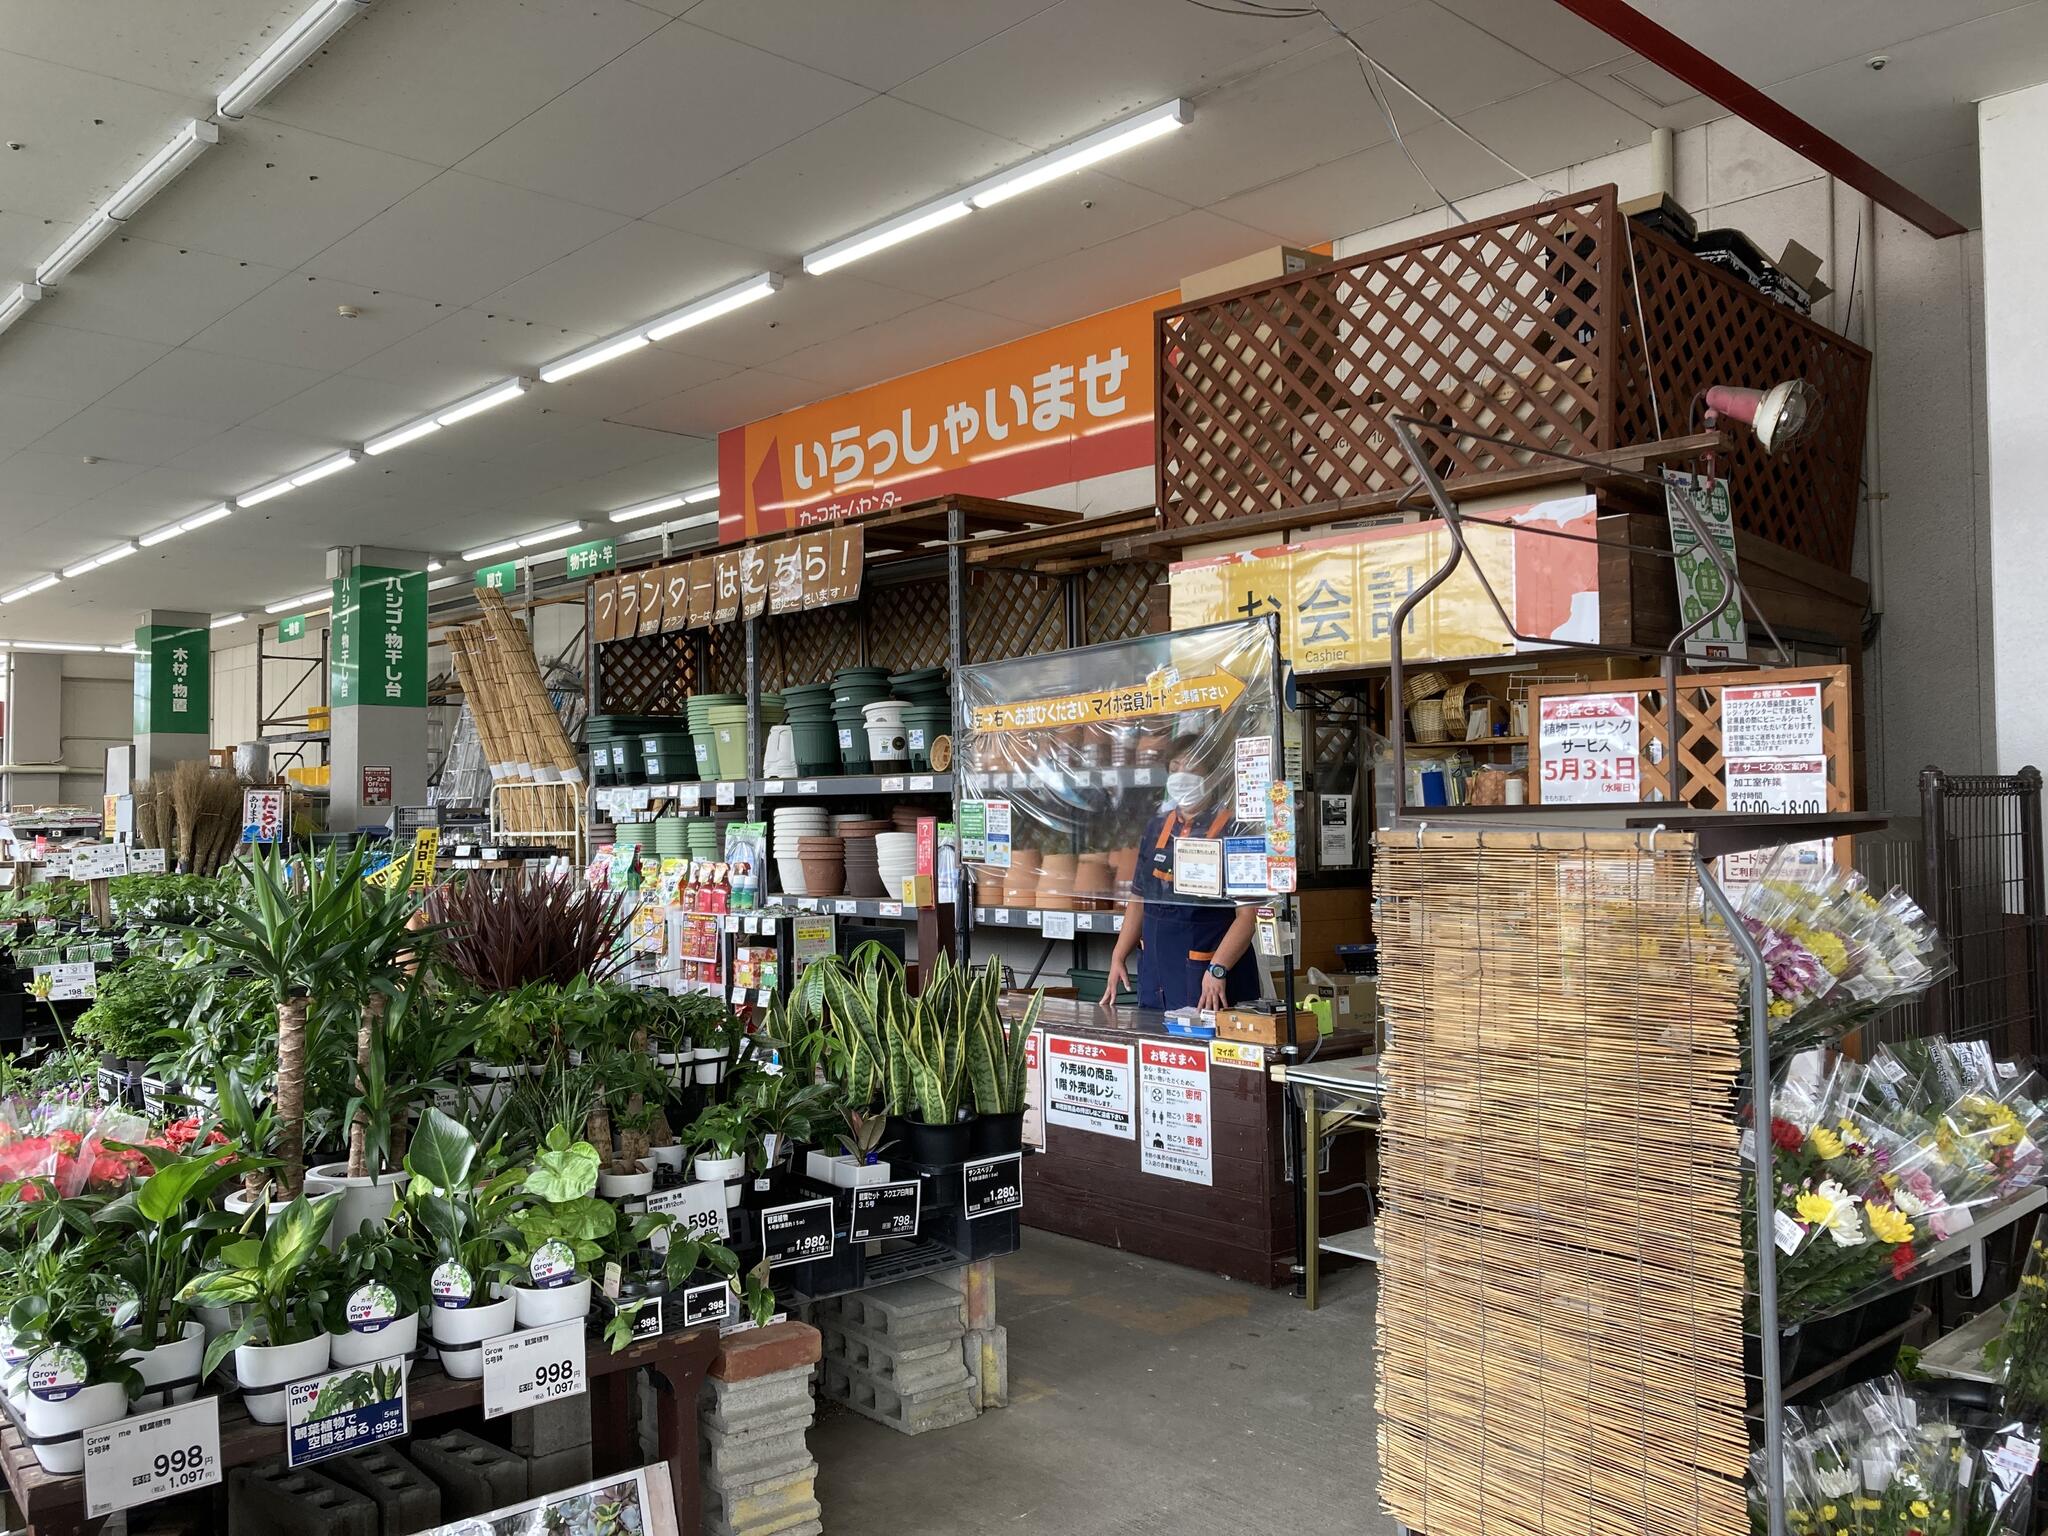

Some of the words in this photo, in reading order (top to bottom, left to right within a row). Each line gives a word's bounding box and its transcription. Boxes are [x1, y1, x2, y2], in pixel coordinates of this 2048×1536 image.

[794, 346, 1129, 490] いらっしゃいませ
[384, 576, 404, 698] ハシゴ・物干し台
[1305, 648, 1348, 664] Cashier
[1555, 701, 1625, 717] お客さまへ
[1544, 719, 1632, 738] 植物ラッピング
[1561, 739, 1611, 754] サービス
[1544, 757, 1636, 781] 5月31日
[1742, 762, 1809, 772] サービスのご案内
[1731, 792, 1763, 800] 受付時間
[1069, 1043, 1107, 1057] お客さまへ
[1150, 1049, 1197, 1066] お客さまへ
[534, 1261, 553, 1271] Grow
[433, 1279, 452, 1287] Grow
[350, 1304, 373, 1312] Grow
[485, 1347, 503, 1356] Grow
[509, 1342, 519, 1350] me
[32, 1369, 58, 1379] Grow
[290, 1382, 320, 1395] Grow
[291, 1395, 308, 1406] me
[87, 1434, 111, 1446] Grow
[118, 1429, 131, 1438] me
[139, 1418, 171, 1433] 観葉植物
[294, 1413, 357, 1441] 観葉植物で
[307, 1421, 369, 1450] 空間を飾る
[87, 1444, 110, 1457] 5号鉢
